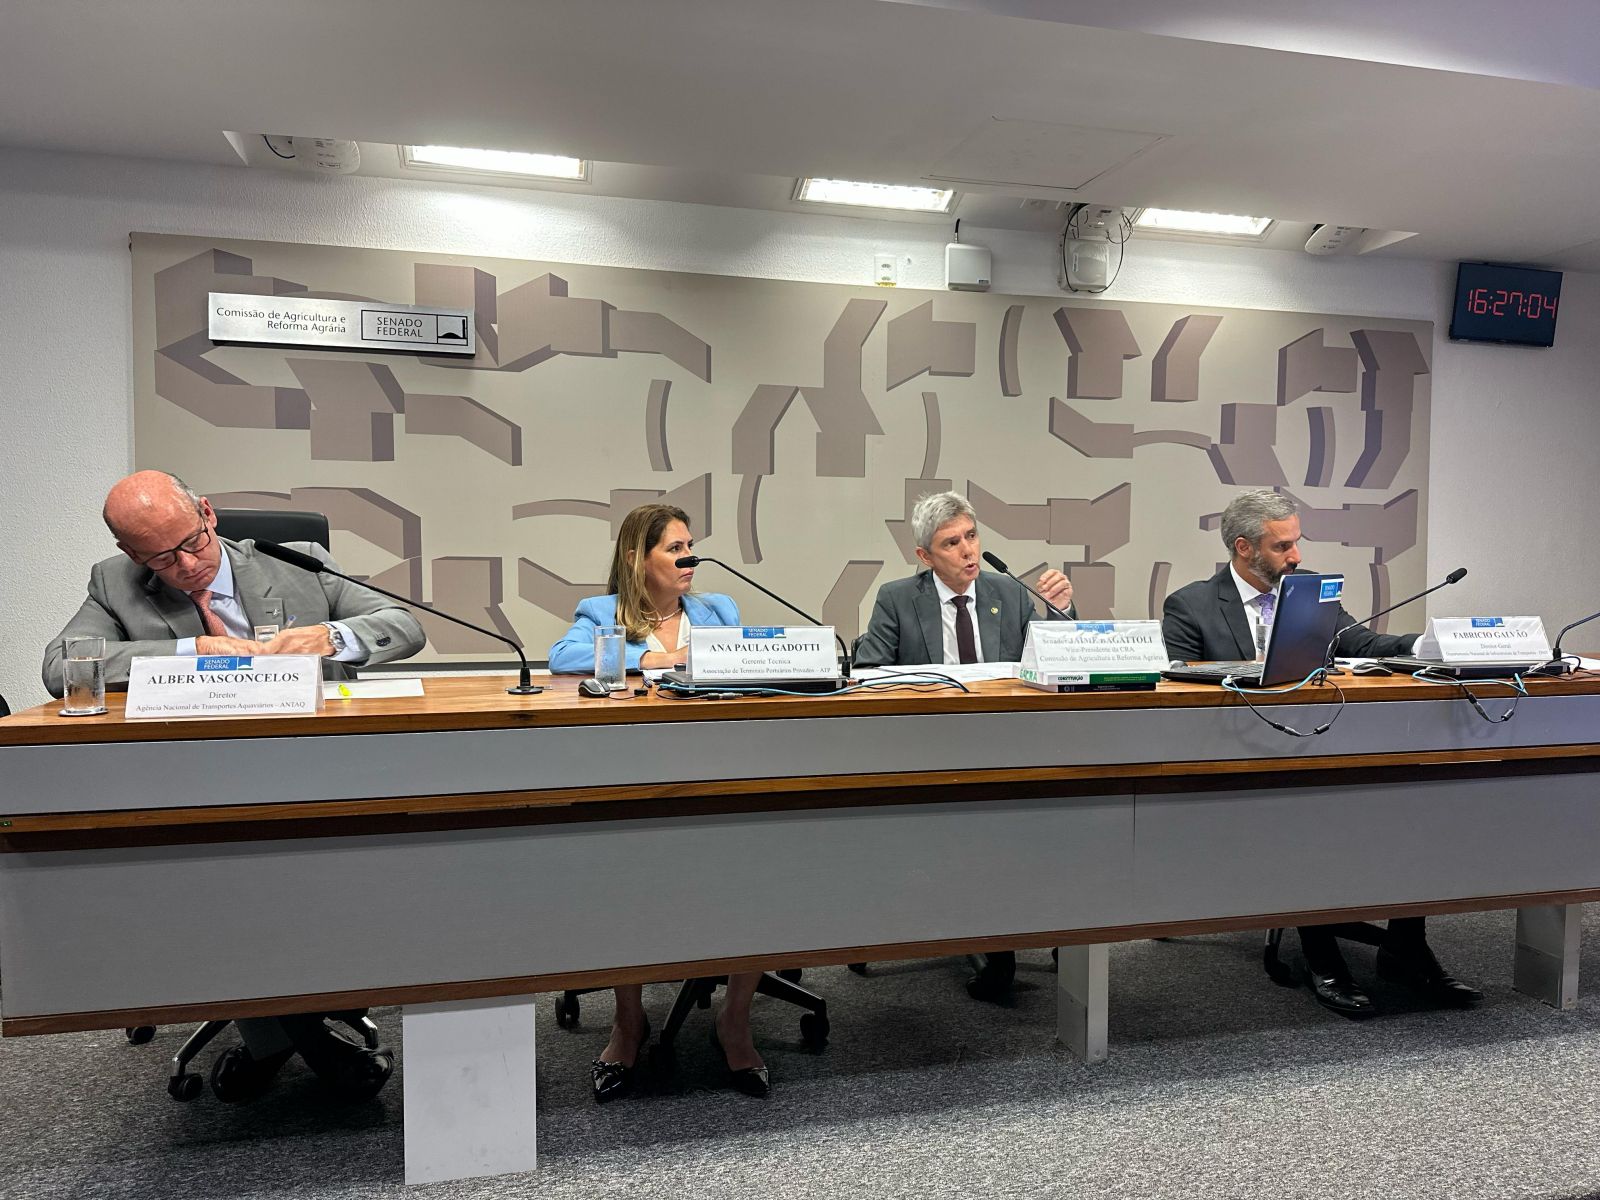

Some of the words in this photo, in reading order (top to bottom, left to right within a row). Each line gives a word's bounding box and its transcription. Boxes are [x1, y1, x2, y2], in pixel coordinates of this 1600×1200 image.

[1468, 289, 1558, 319] 16:27:04
[216, 307, 265, 319] Comissão
[268, 310, 281, 320] de
[283, 311, 338, 323] Agricultura
[267, 320, 308, 331] Reforma
[311, 323, 346, 335] Agrária
[377, 316, 423, 328] SENADO
[377, 327, 423, 338] FEDERAL
[1453, 631, 1493, 640] FABRICIO
[1494, 629, 1528, 639] GALVÃO
[709, 643, 732, 652] ANA
[734, 643, 770, 652] PAULA
[771, 643, 820, 652] GADOTTI
[147, 673, 196, 685] ALBER
[199, 672, 300, 684] VASCONCELOS
[209, 691, 238, 700] Diretor
[136, 704, 162, 713] Agência
[163, 703, 191, 711] Nacional
[201, 702, 236, 712] Transportes
[279, 701, 306, 710] ANTAQ
